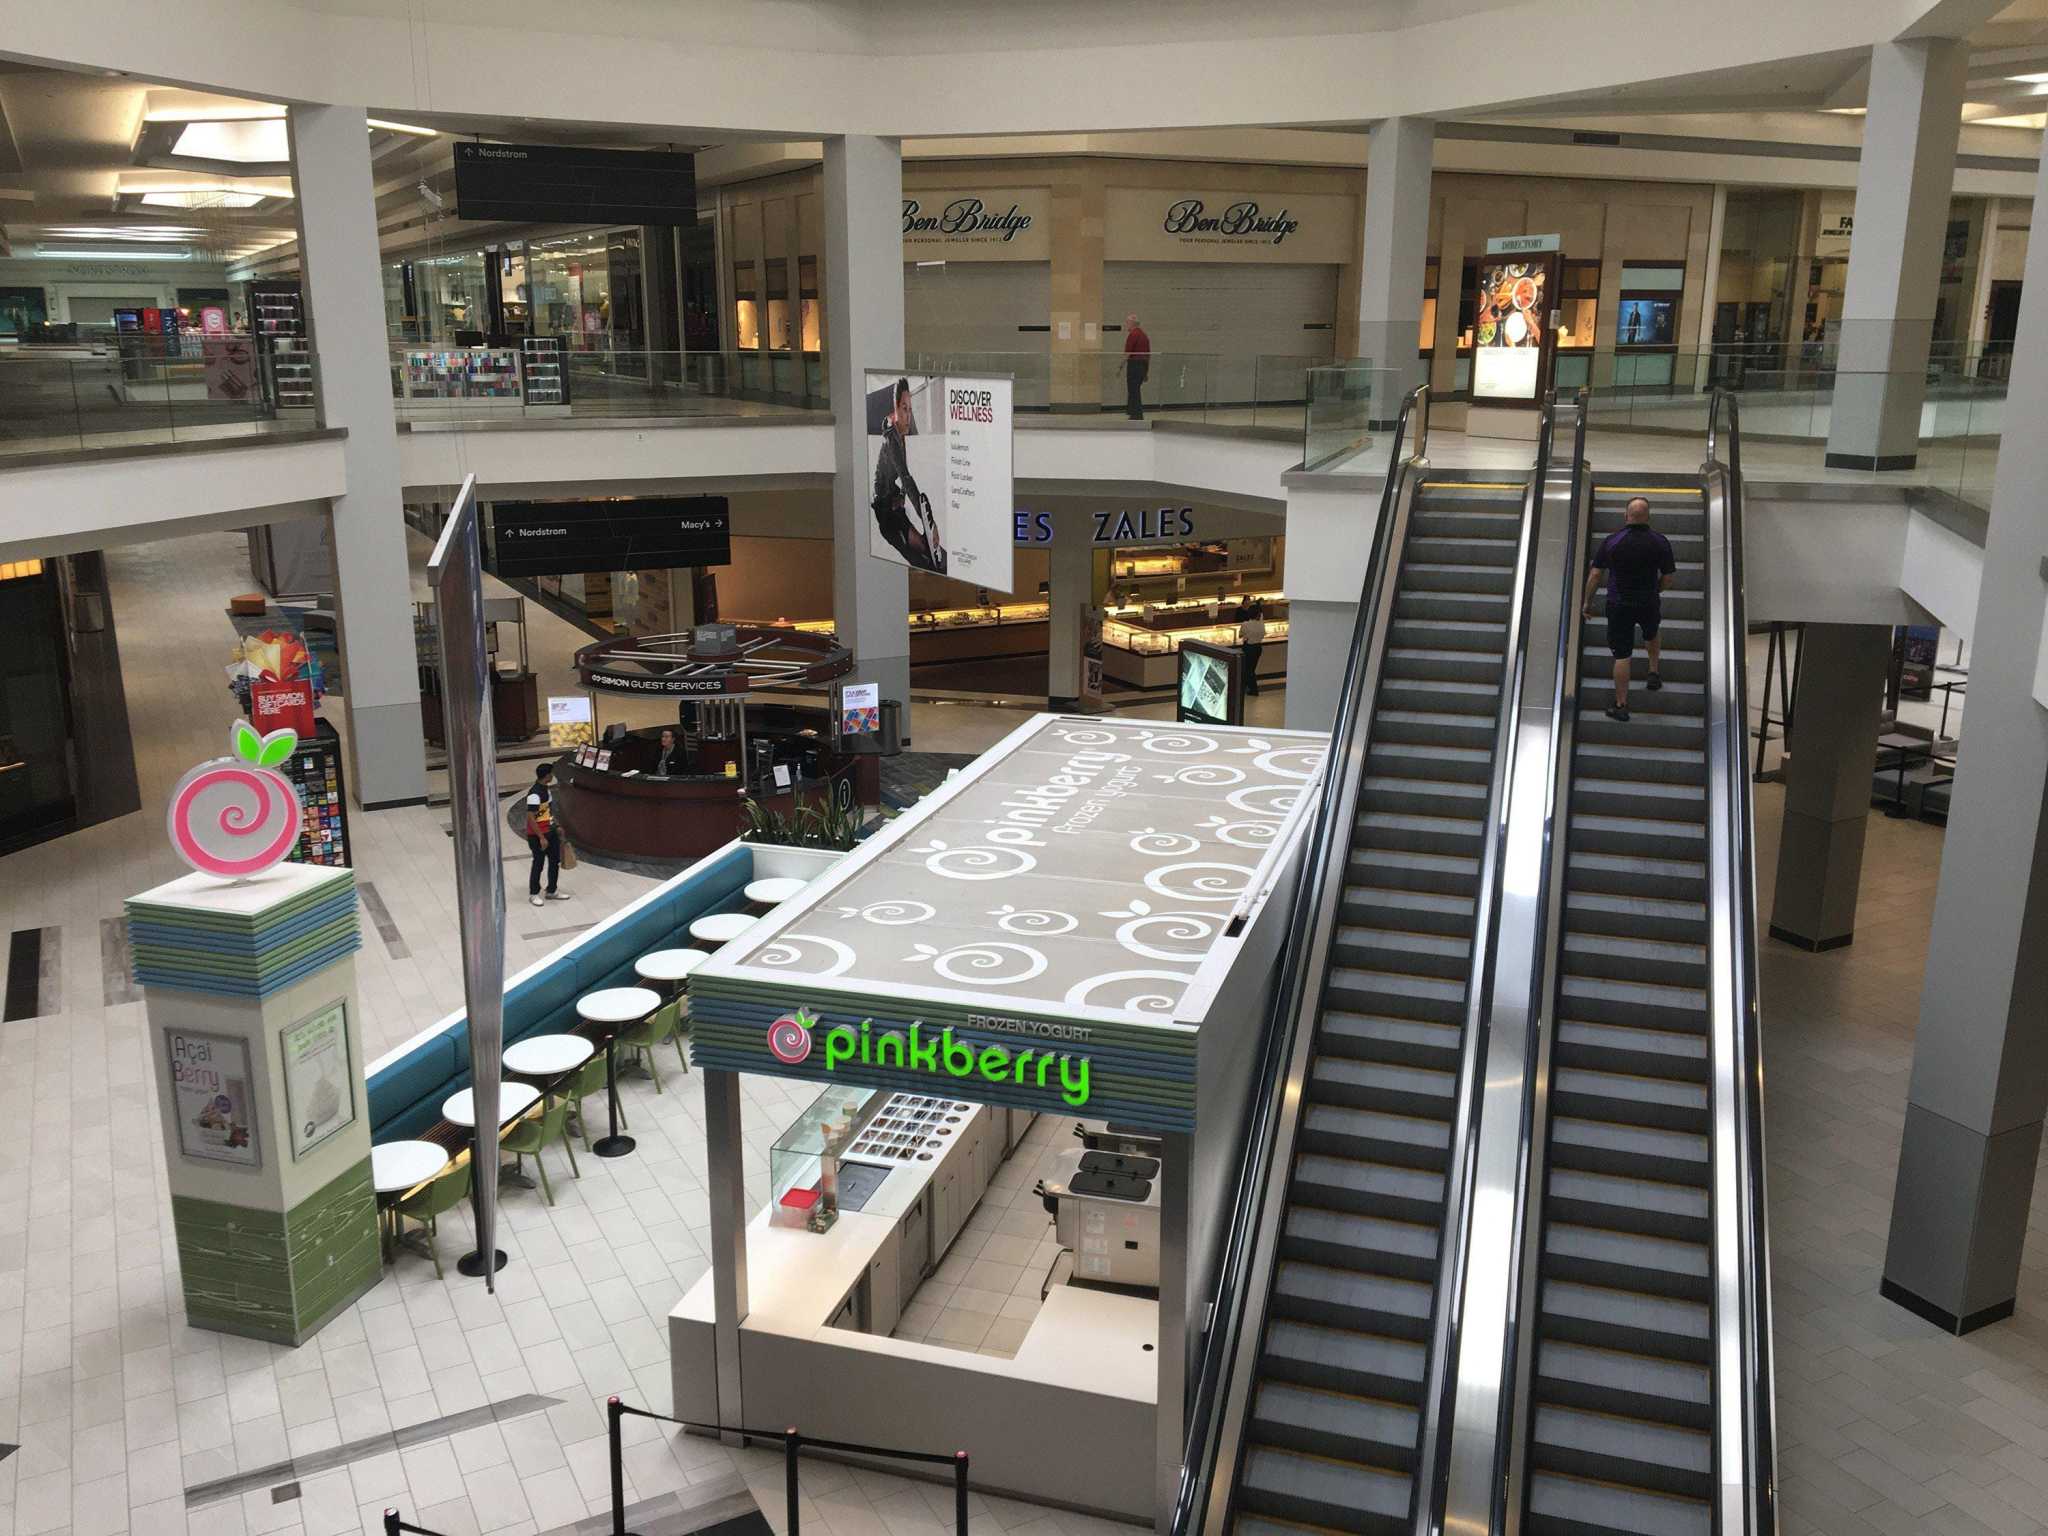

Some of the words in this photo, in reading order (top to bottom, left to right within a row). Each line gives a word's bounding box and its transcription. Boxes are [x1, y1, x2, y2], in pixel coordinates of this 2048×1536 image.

[479, 148, 528, 159] Nordstrom
[940, 199, 1032, 242] Bridge
[1164, 200, 1220, 233] Ben
[1220, 202, 1298, 244] Bridge
[1840, 216, 1853, 229] FA
[950, 389, 992, 406] DISCOVER
[950, 405, 993, 423] WELLNESS
[519, 527, 567, 537] Nordstrom
[681, 519, 710, 530] Macy's
[1093, 507, 1194, 542] ZALES
[600, 678, 630, 688] SIMON
[630, 680, 664, 690] GUEST
[666, 681, 722, 690] SERVICES
[984, 750, 1133, 847] pinkberry
[1051, 799, 1112, 835] frozen
[1095, 765, 1143, 798] yogurt
[967, 1014, 1026, 1034] FROZEN
[1031, 1020, 1092, 1042] YOGURT
[173, 1060, 219, 1092] Berry
[825, 1020, 1091, 1107] pinkberry
